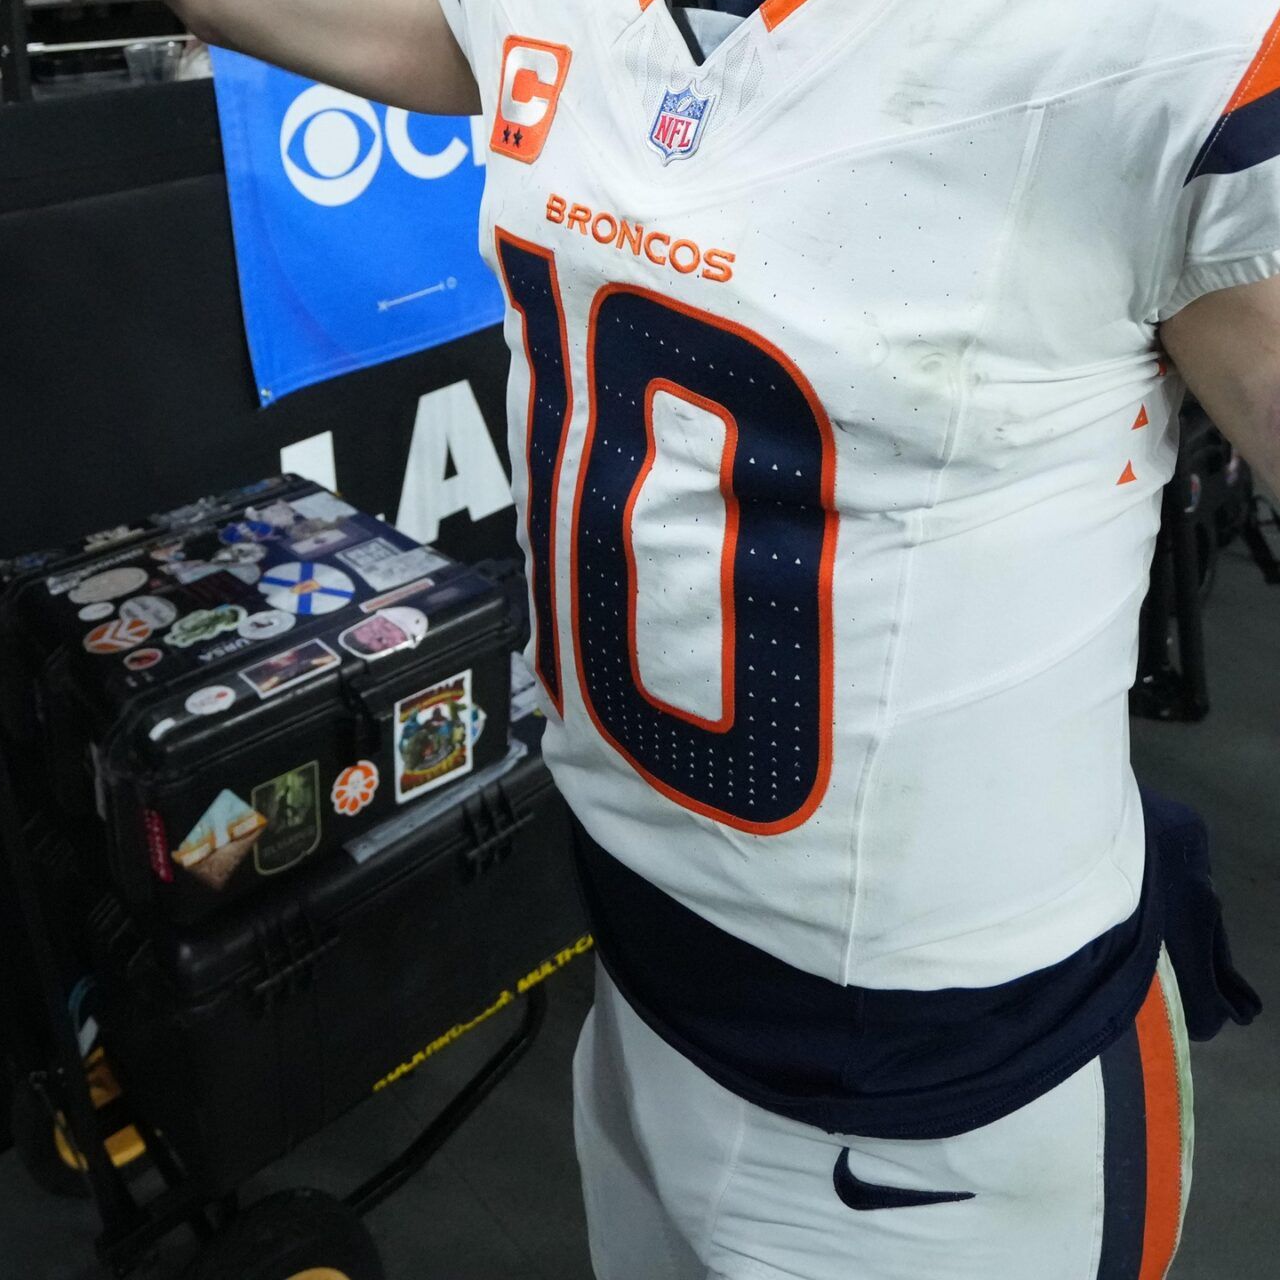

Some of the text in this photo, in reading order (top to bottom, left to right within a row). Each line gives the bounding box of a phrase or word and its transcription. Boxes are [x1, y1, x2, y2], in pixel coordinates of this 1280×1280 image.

[501, 46, 559, 128] C
[653, 114, 693, 150] NFL
[546, 193, 736, 283] BRONCOS
[494, 224, 840, 837] 10
